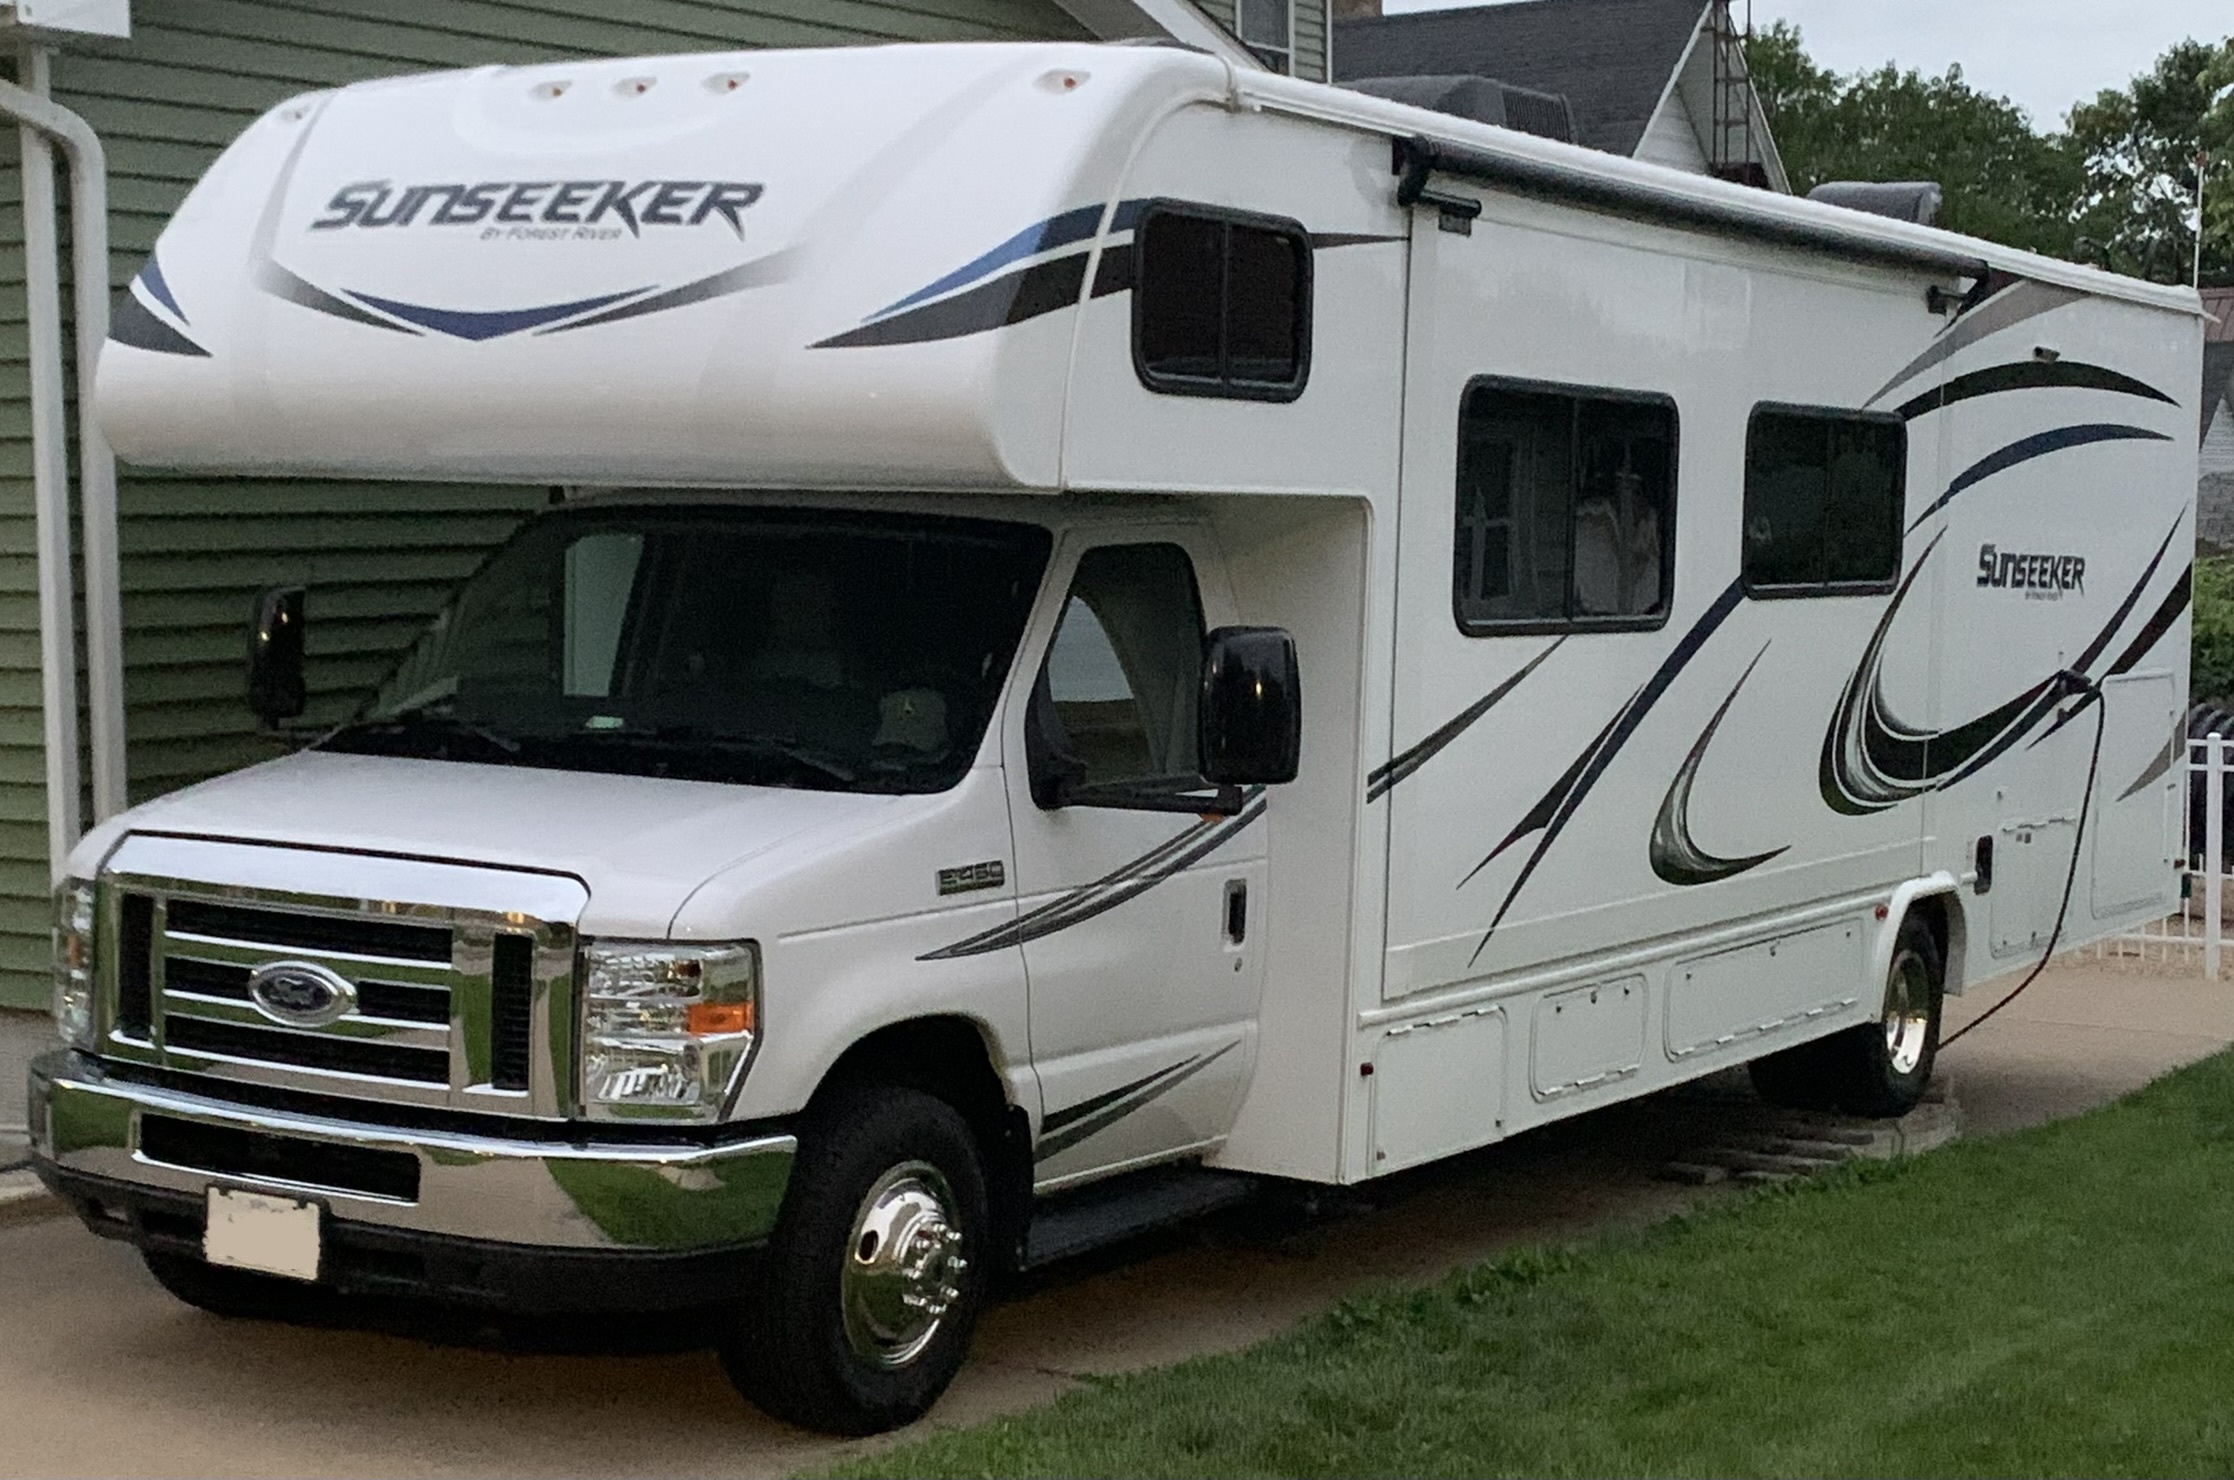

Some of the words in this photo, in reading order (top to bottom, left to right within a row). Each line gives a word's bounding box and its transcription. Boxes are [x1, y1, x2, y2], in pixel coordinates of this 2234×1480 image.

[310, 179, 766, 241] SUNSEEKER
[508, 227, 570, 240] FOREST
[572, 226, 621, 240] RIVER
[1976, 543, 2086, 597] SUNSEEKER
